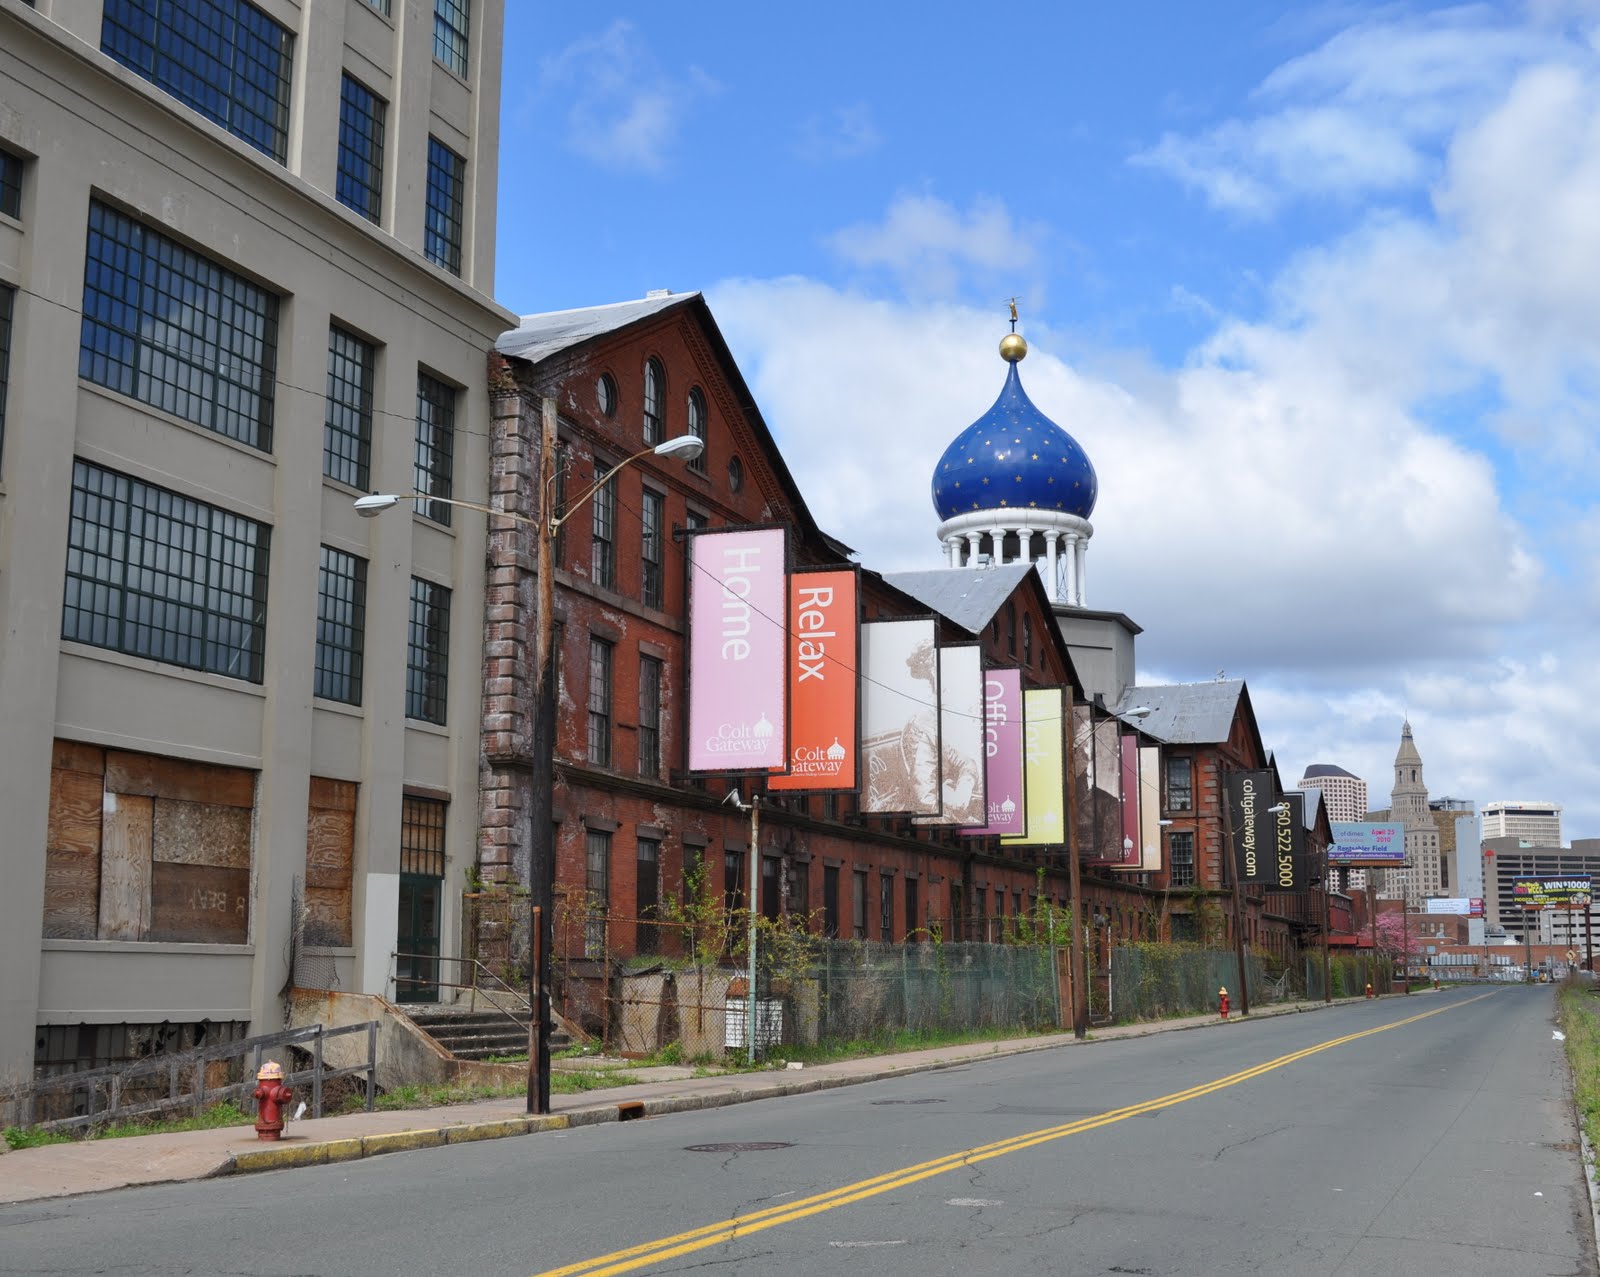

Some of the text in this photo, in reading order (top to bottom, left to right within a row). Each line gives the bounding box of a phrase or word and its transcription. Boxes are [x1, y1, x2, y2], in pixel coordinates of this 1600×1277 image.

[723, 547, 761, 660] Home
[798, 586, 836, 682] Relax
[719, 723, 751, 738] Colt
[985, 680, 1007, 757] Office
[706, 737, 770, 753] Gateway
[795, 747, 825, 760] Colt
[988, 802, 1000, 812] olt
[1241, 779, 1257, 876] coltgateway.com
[1277, 802, 1293, 887] 860.522.5000
[1544, 881, 1562, 889] WIN
